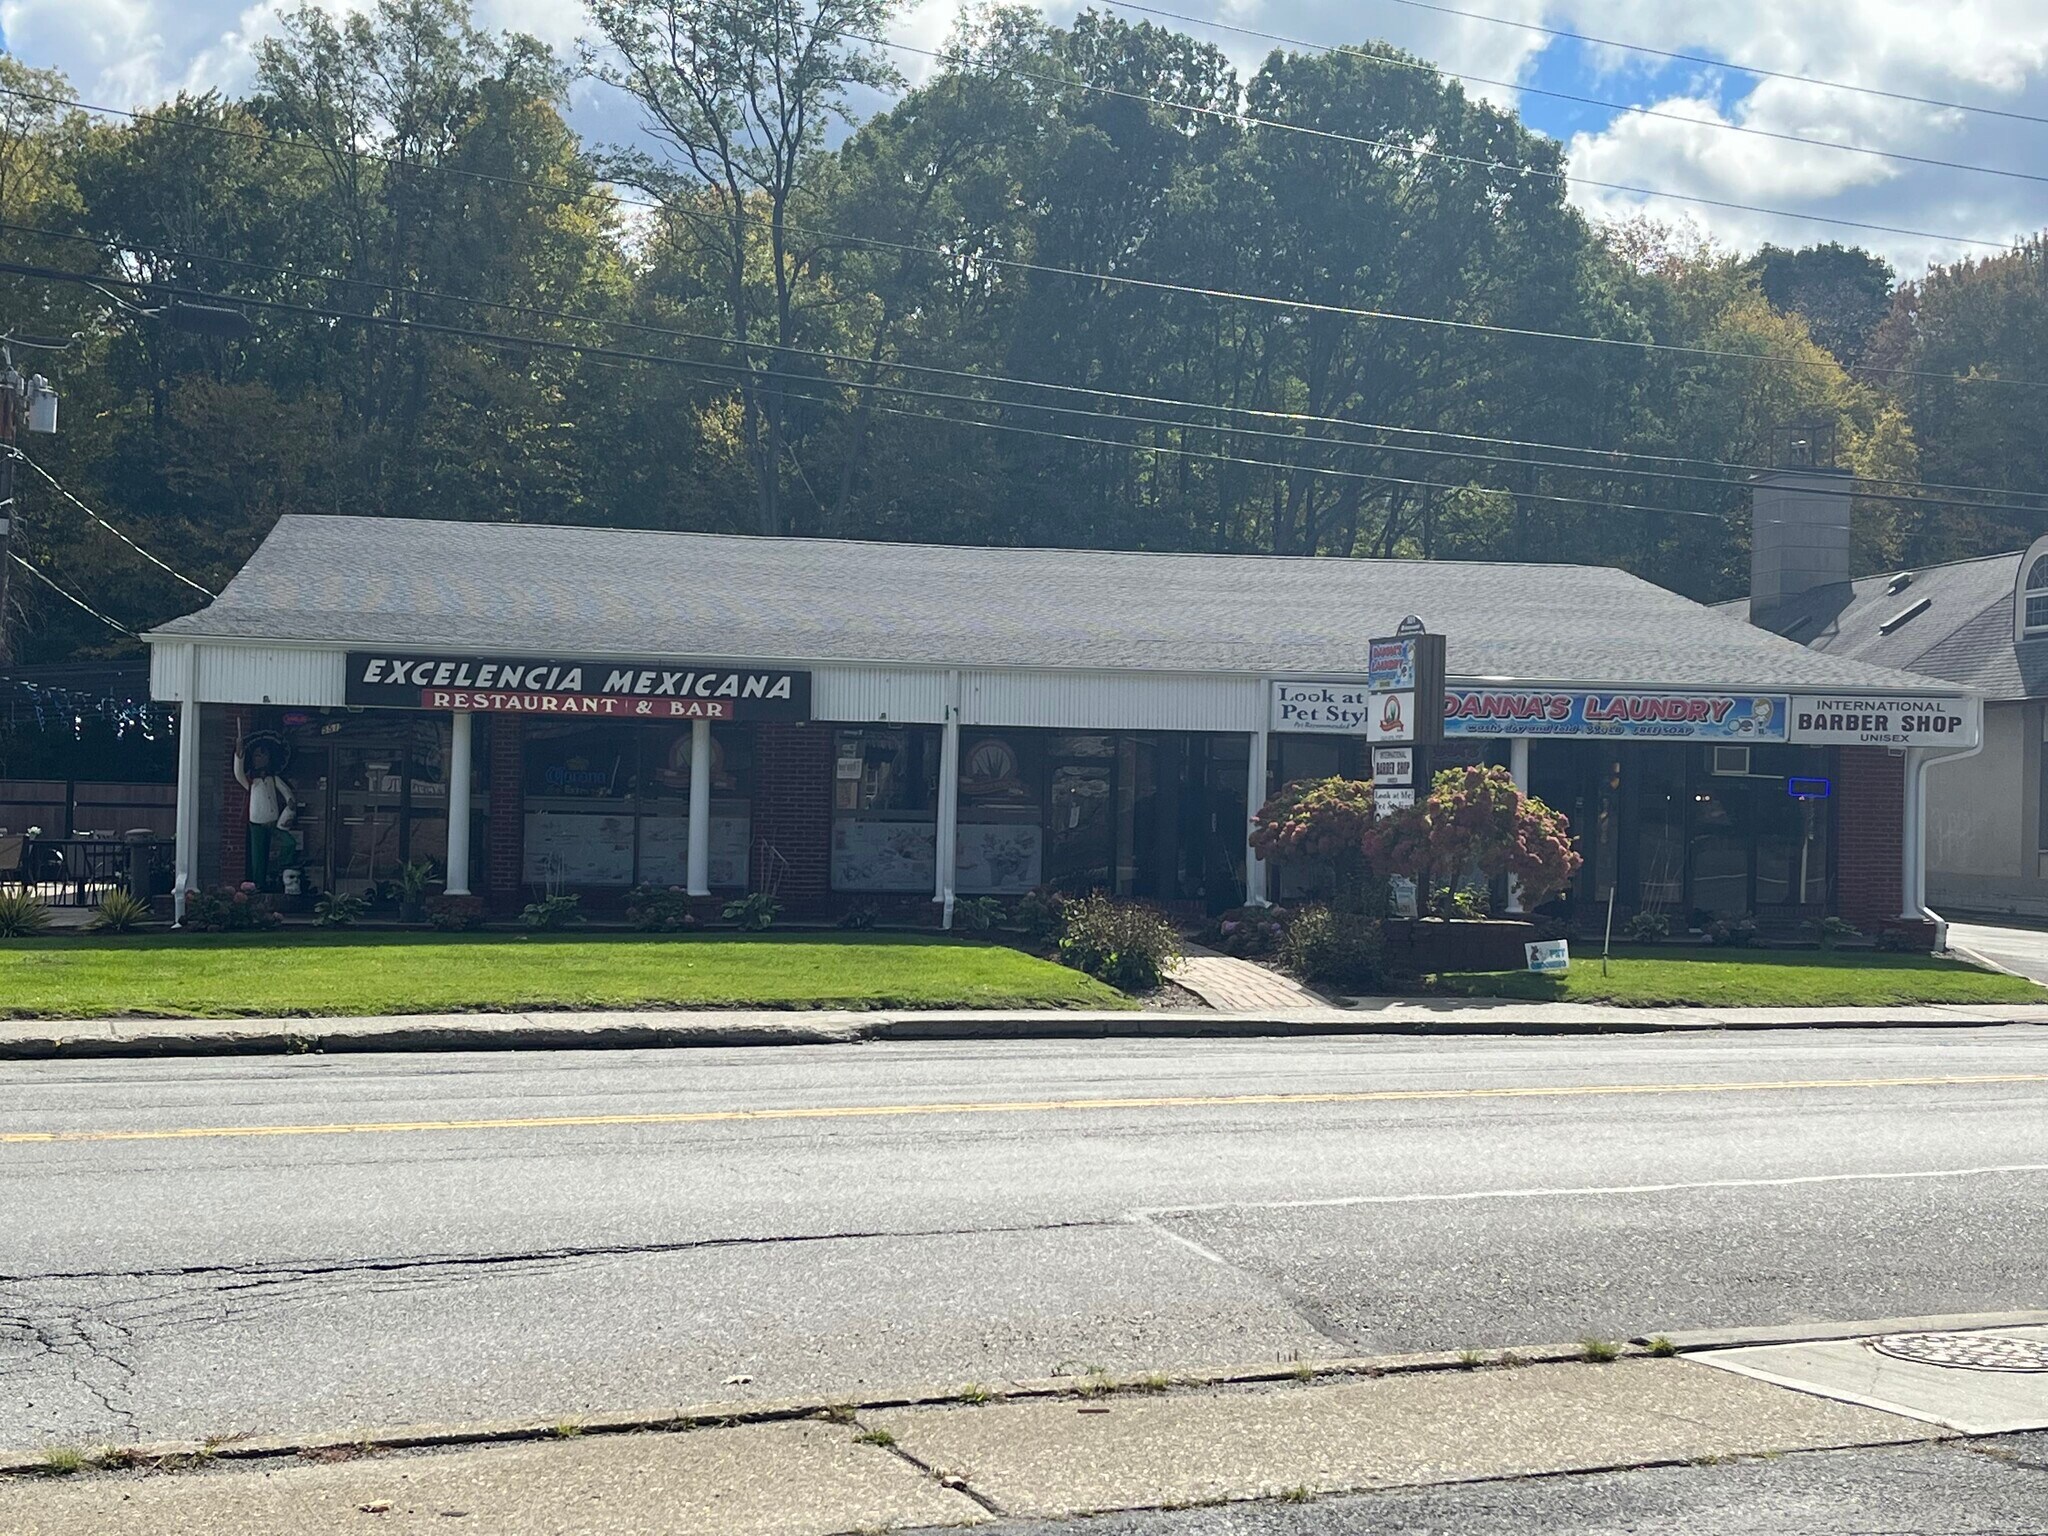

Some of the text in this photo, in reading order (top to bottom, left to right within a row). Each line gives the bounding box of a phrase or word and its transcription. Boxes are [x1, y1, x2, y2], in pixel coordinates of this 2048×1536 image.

[363, 658, 792, 699] EXCELENCIA MEXICANA
[1279, 687, 1363, 704] Look at
[433, 692, 724, 717] RESTAURANT & BAR
[1281, 704, 1319, 721] Pet
[1585, 696, 1735, 722] LAUNDRY
[1816, 700, 1946, 712] INTERNATIONAL
[1504, 724, 1526, 734] dry
[1526, 725, 1550, 733] and
[1633, 726, 1660, 736] FREE
[1662, 727, 1694, 736] SOAP
[1798, 713, 1962, 733] BARBER SHOP
[1860, 734, 1909, 742] UNISEX
